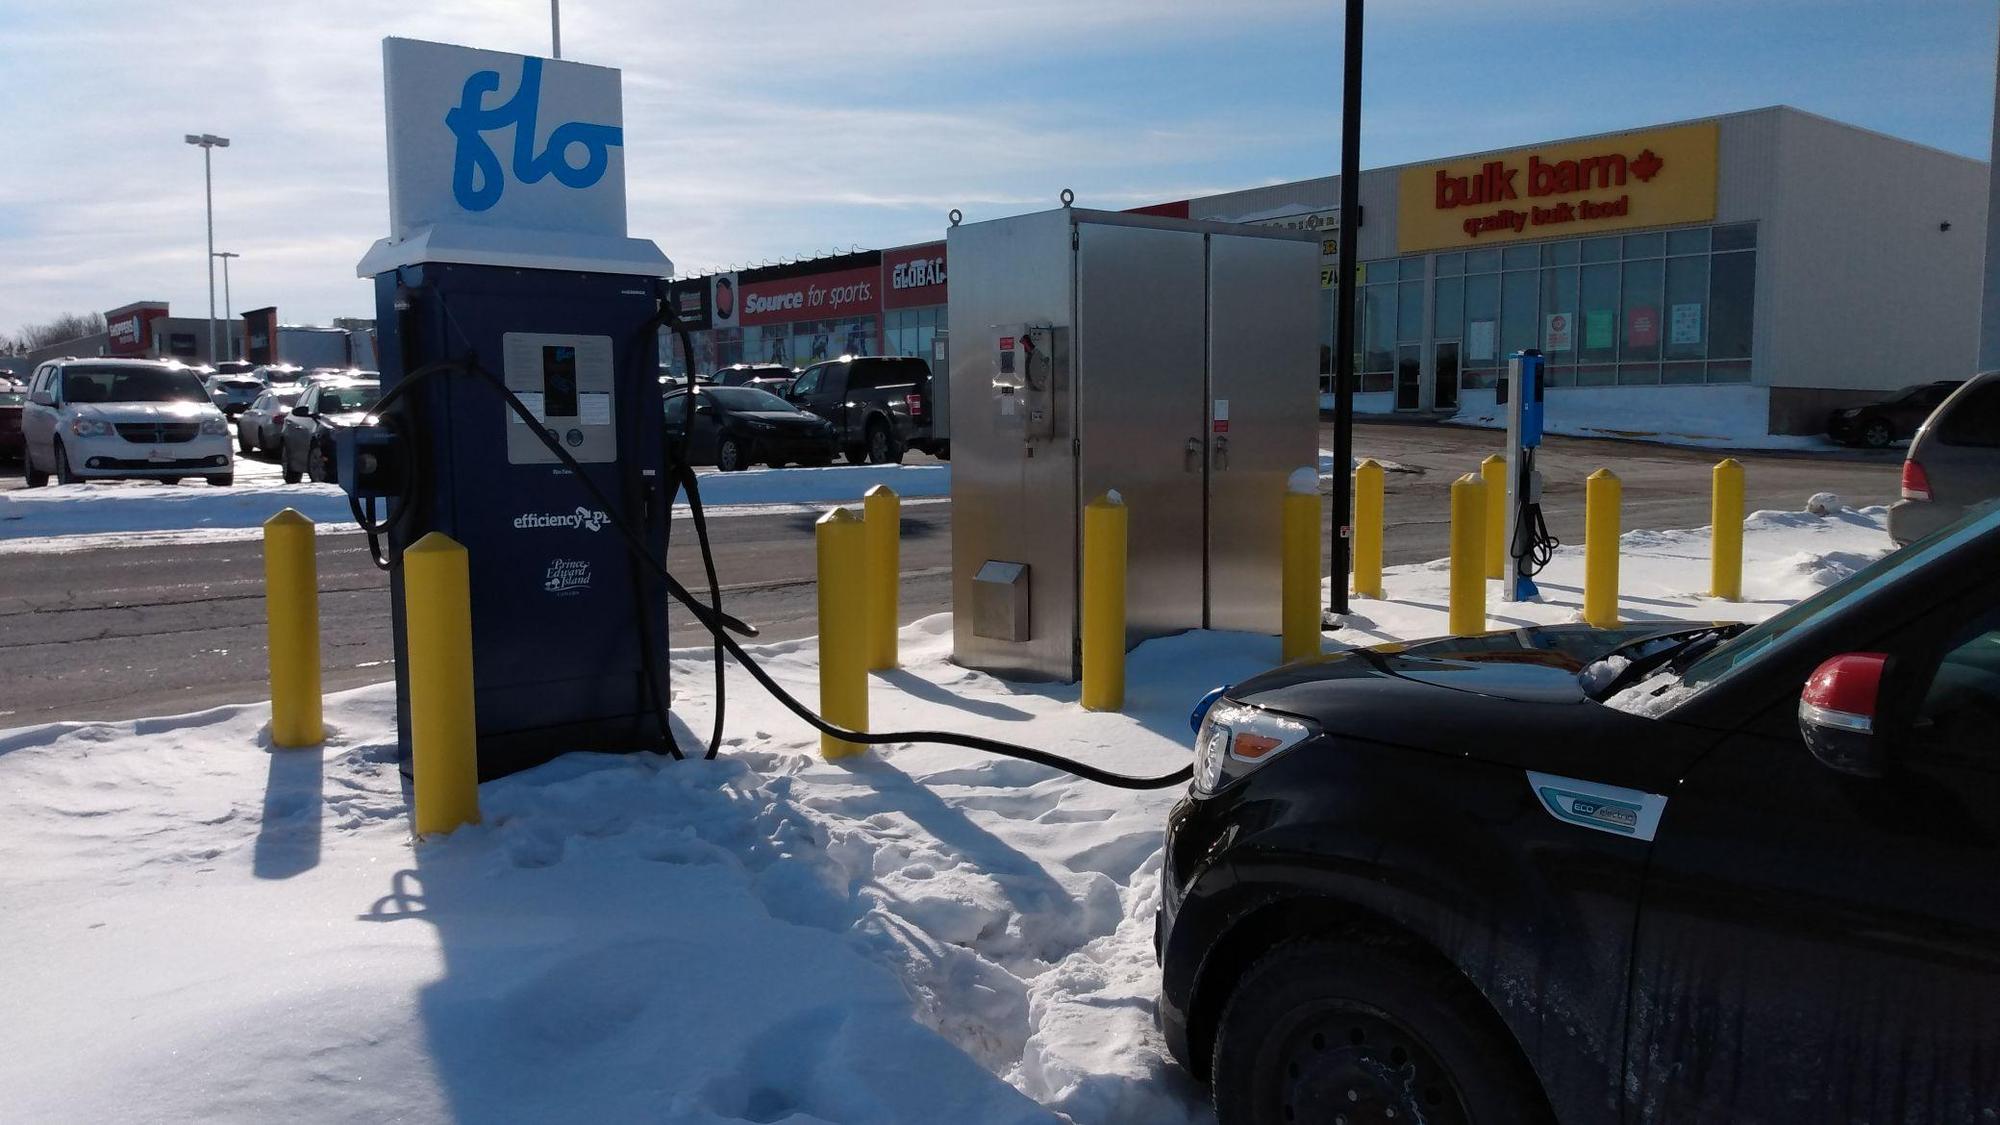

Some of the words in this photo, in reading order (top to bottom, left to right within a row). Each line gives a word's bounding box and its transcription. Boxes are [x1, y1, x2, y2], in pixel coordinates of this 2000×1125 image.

[444, 55, 623, 213] flo
[1435, 160, 1519, 209] bulk
[1528, 153, 1627, 198] barn
[1463, 209, 1528, 238] quality
[1531, 202, 1575, 226] bulk
[1578, 196, 1628, 220] food
[893, 257, 945, 289] GLOBAL
[745, 291, 804, 314] Source
[807, 284, 827, 307] for
[513, 512, 583, 529] efficiency
[545, 567, 585, 578] Edward
[551, 558, 591, 569] Prince
[561, 572, 591, 588] Island
[1574, 803, 1594, 814] ECO
[1599, 808, 1633, 821] electric
